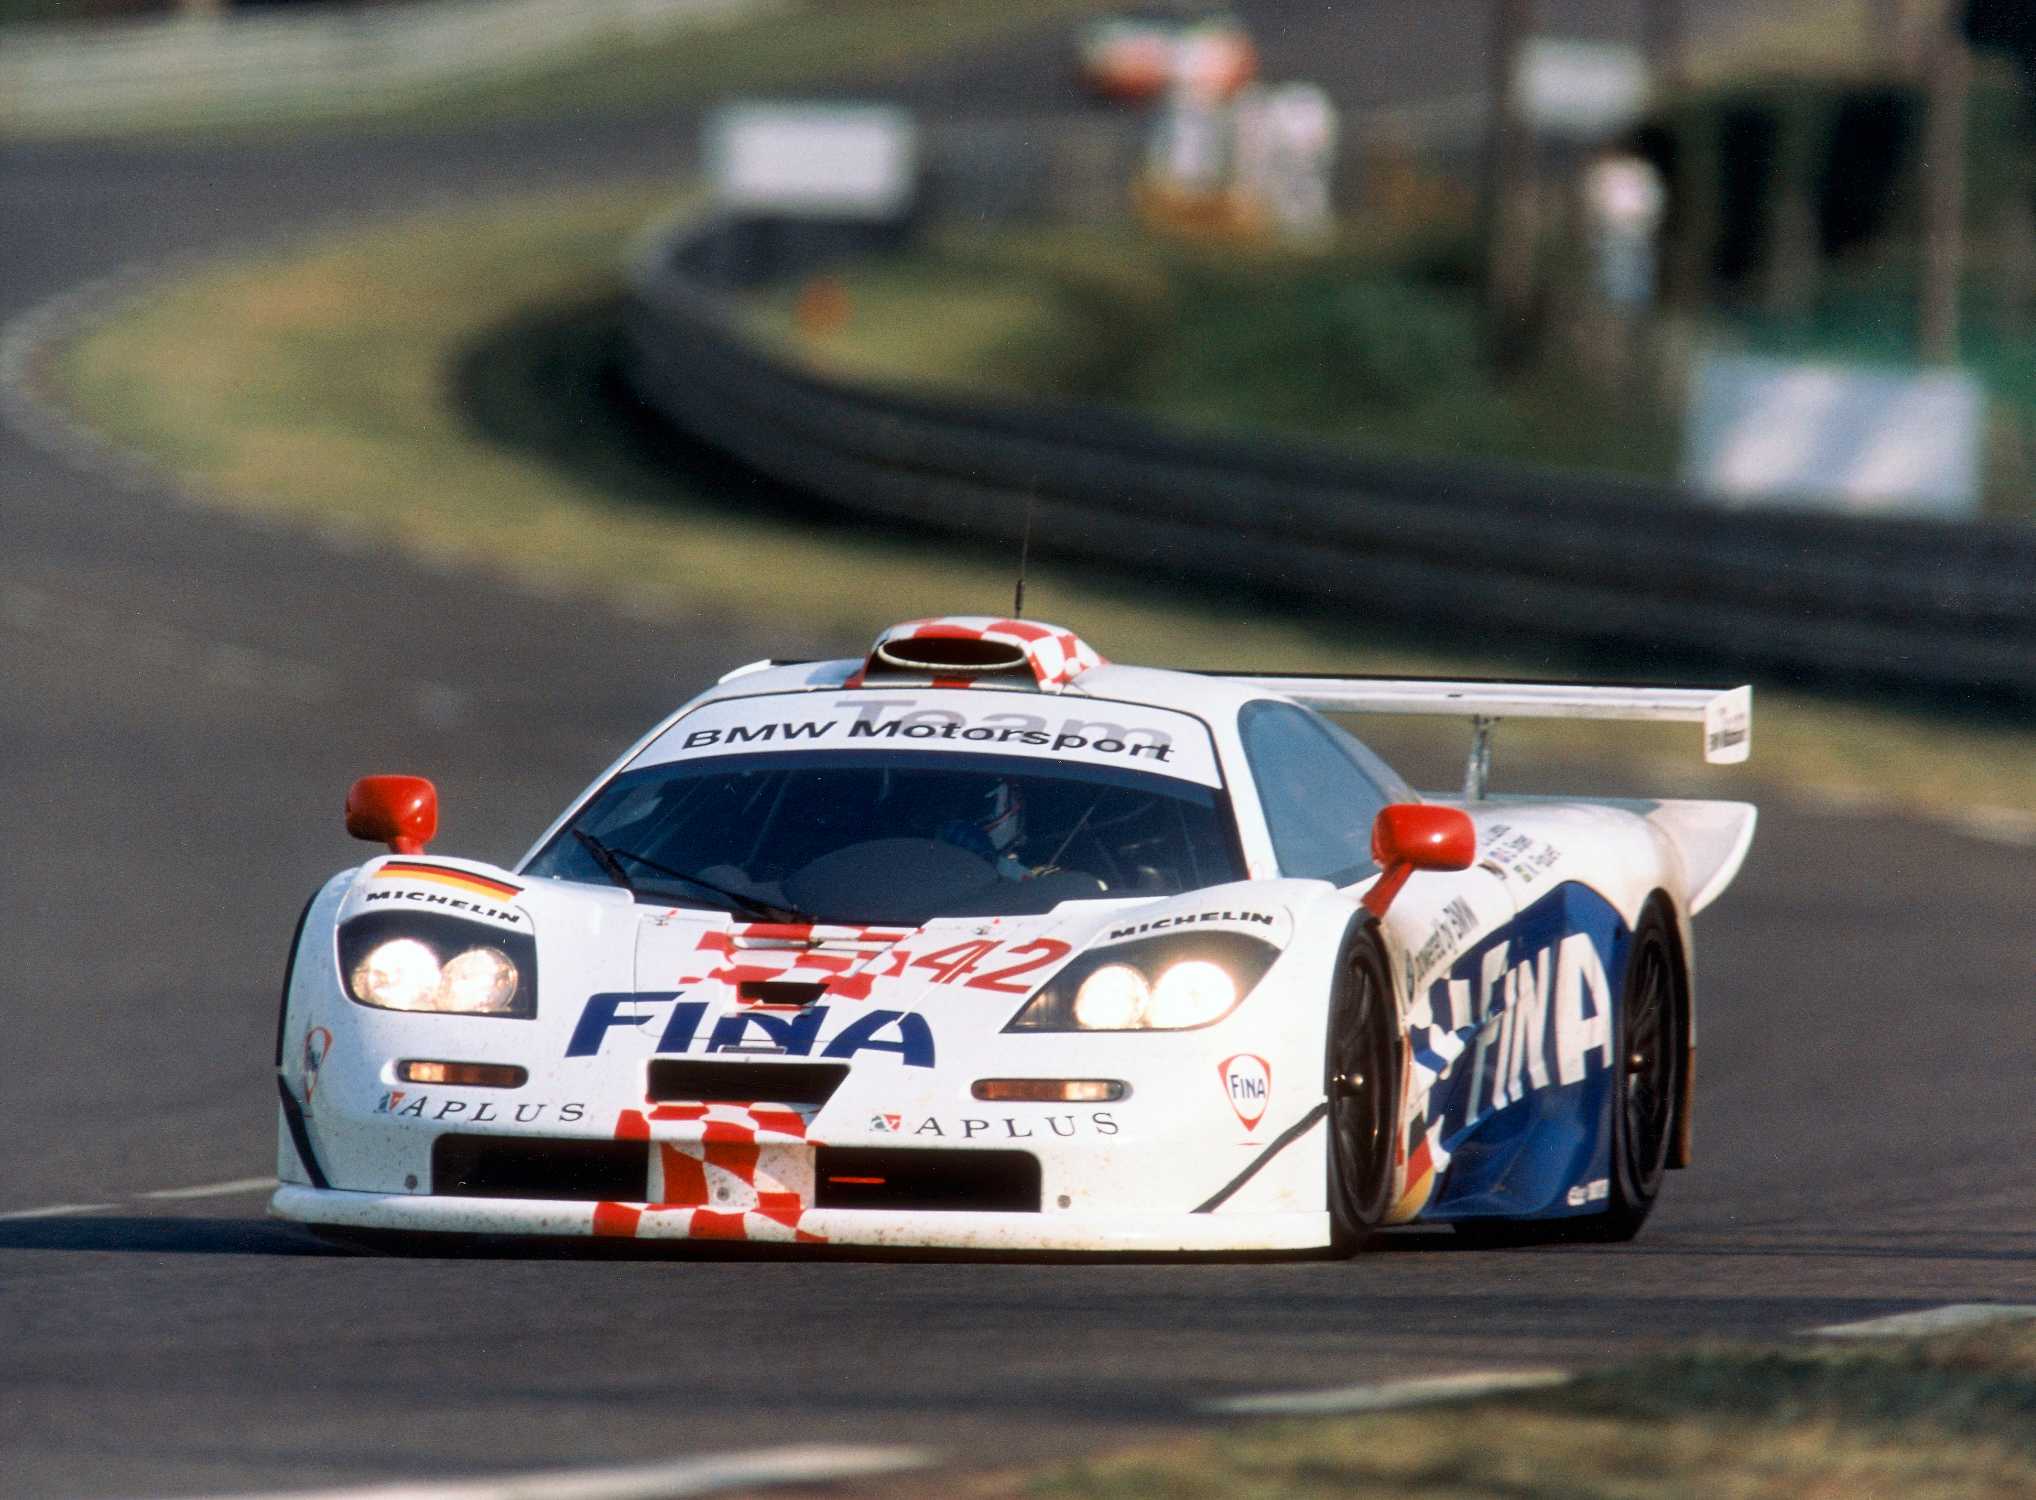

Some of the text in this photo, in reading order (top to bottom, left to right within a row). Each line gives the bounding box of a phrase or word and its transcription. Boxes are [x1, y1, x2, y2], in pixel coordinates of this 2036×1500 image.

[682, 720, 1175, 763] BMW Motorsport
[834, 700, 1172, 759] Team
[366, 891, 520, 923] MICHELIN
[1110, 912, 1274, 939] MICHELIN
[909, 937, 1072, 994] 42
[564, 991, 935, 1068] FINA
[1466, 932, 1613, 1127] FINA
[1230, 1074, 1266, 1099] FINA
[398, 1095, 585, 1122] APLUS
[915, 1112, 1119, 1138] APLUS
